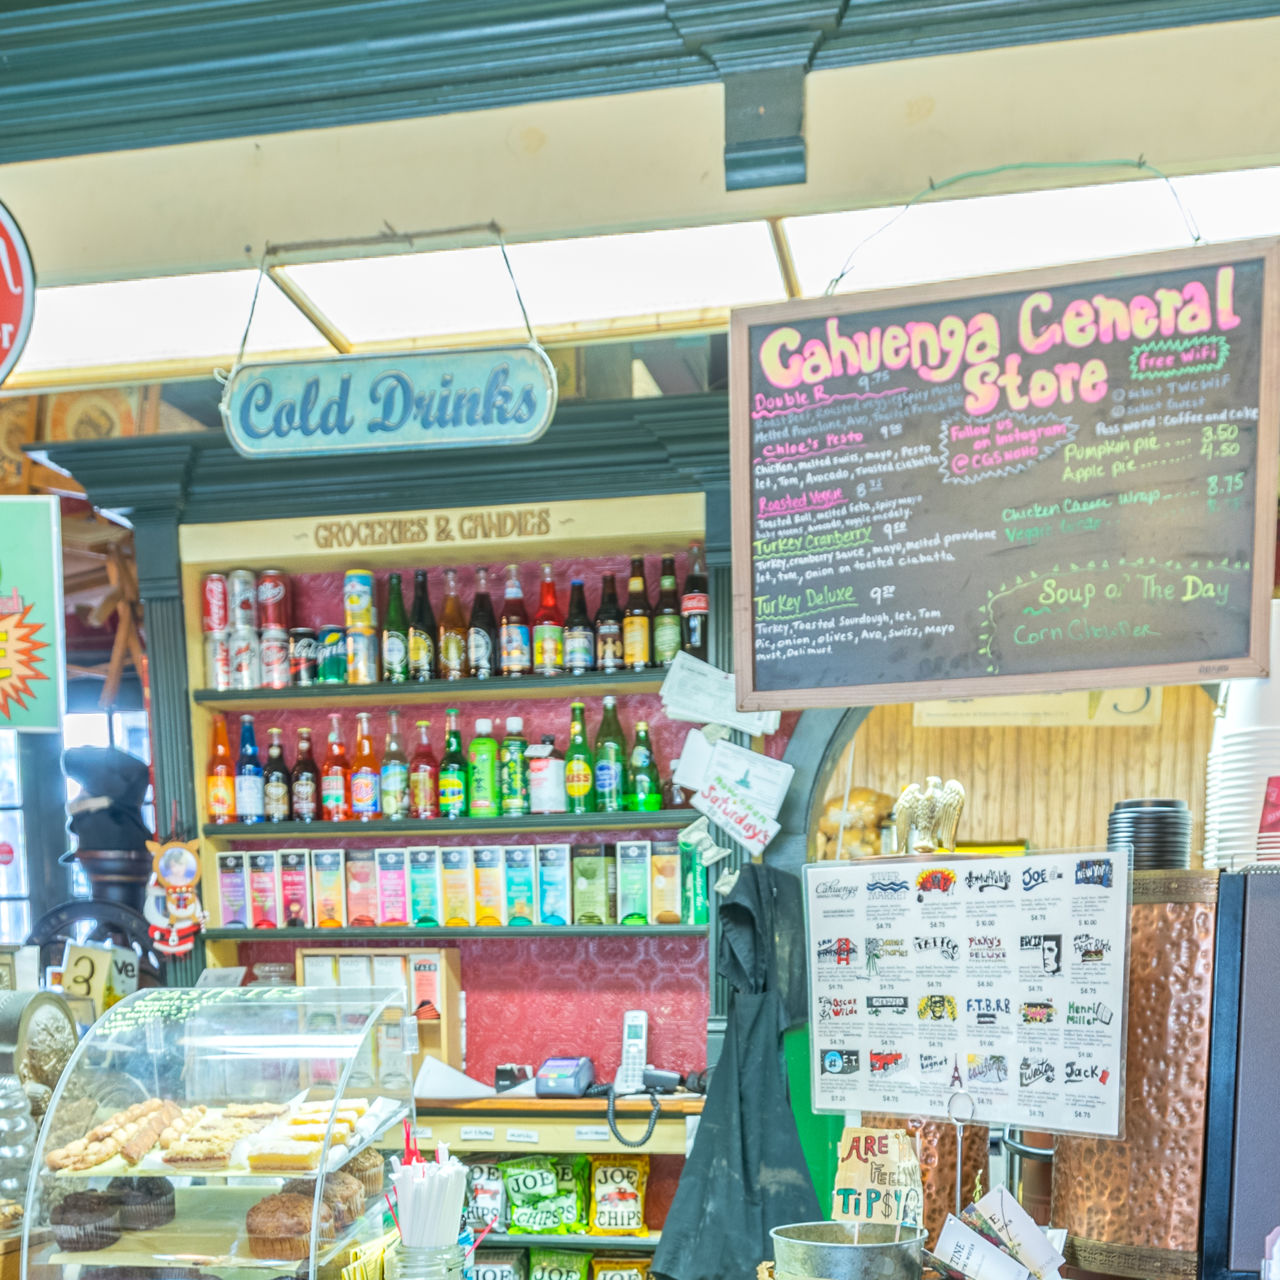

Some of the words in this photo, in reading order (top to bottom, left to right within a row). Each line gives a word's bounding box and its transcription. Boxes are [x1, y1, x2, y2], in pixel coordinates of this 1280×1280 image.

[759, 312, 1000, 388] Cahuenga
[1019, 265, 1241, 354] General
[1138, 352, 1175, 371] free
[964, 354, 1108, 416] Store
[239, 373, 355, 440] Cold
[367, 362, 538, 433] Drinks
[755, 391, 808, 411] Double
[763, 436, 819, 456] Chloe's
[951, 422, 990, 441] Follow
[973, 437, 991, 449] on
[996, 424, 1067, 447] Instagram
[1063, 434, 1130, 463] Pumpkin
[1133, 431, 1161, 457] pie
[1201, 424, 1238, 443] 3.50
[1062, 461, 1106, 483] Apple
[1111, 456, 1138, 477] pie
[1200, 441, 1240, 461] 4.50
[759, 492, 808, 513] Roasted
[1002, 503, 1061, 524] Chicken
[1207, 472, 1245, 496] 8.75
[314, 517, 428, 549] GROCERIES
[435, 515, 455, 541] &
[458, 507, 551, 540] CANDIES
[754, 539, 802, 557] Turkey
[805, 526, 872, 550] Cranberry
[754, 593, 802, 616] Turkey
[805, 584, 857, 608] Deluxe
[1038, 577, 1097, 608] Soup
[1136, 573, 1176, 600] The
[1181, 574, 1231, 606] Day
[1014, 624, 1064, 646] Corn
[841, 1135, 889, 1163] ARE
[511, 1172, 554, 1193] JOE
[598, 1167, 638, 1186] JOE
[516, 1209, 561, 1228] CHIPS
[597, 1210, 641, 1227] CHIPS
